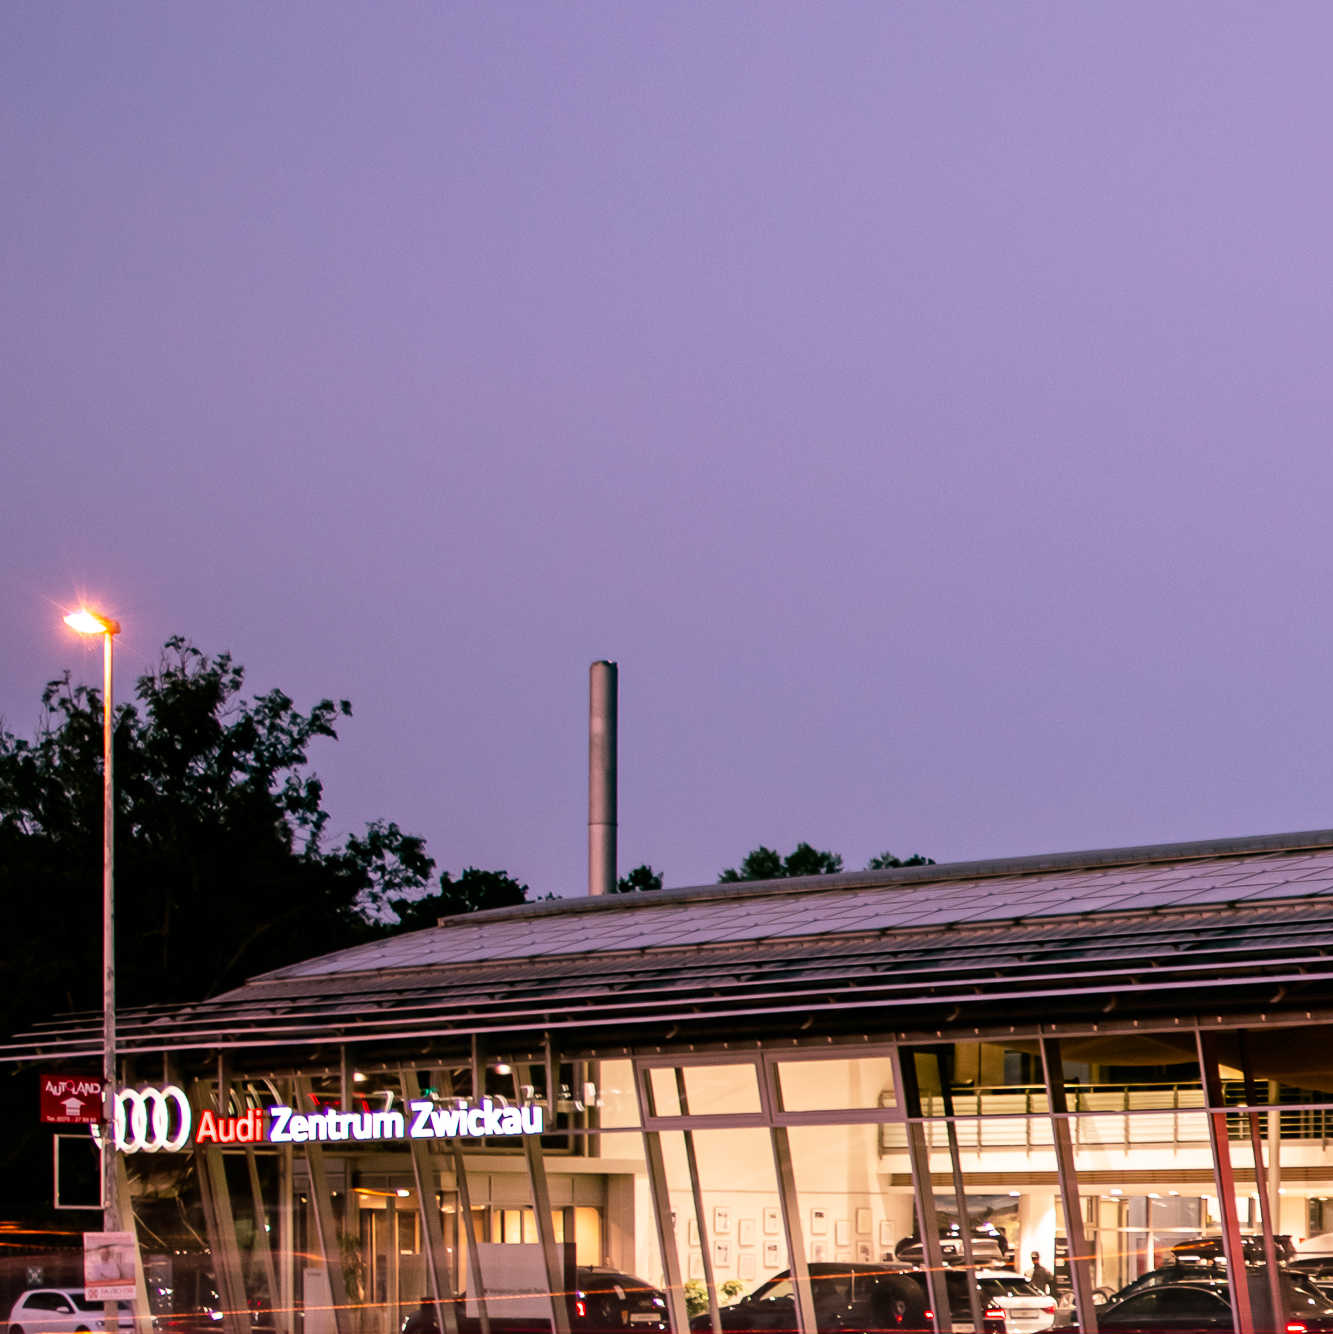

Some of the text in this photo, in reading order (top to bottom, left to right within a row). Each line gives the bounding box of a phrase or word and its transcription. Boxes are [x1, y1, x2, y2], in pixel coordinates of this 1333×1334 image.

[46, 1080, 101, 1096] AUTOLAND
[196, 1099, 543, 1143] Audi Zentrum Zwickau
